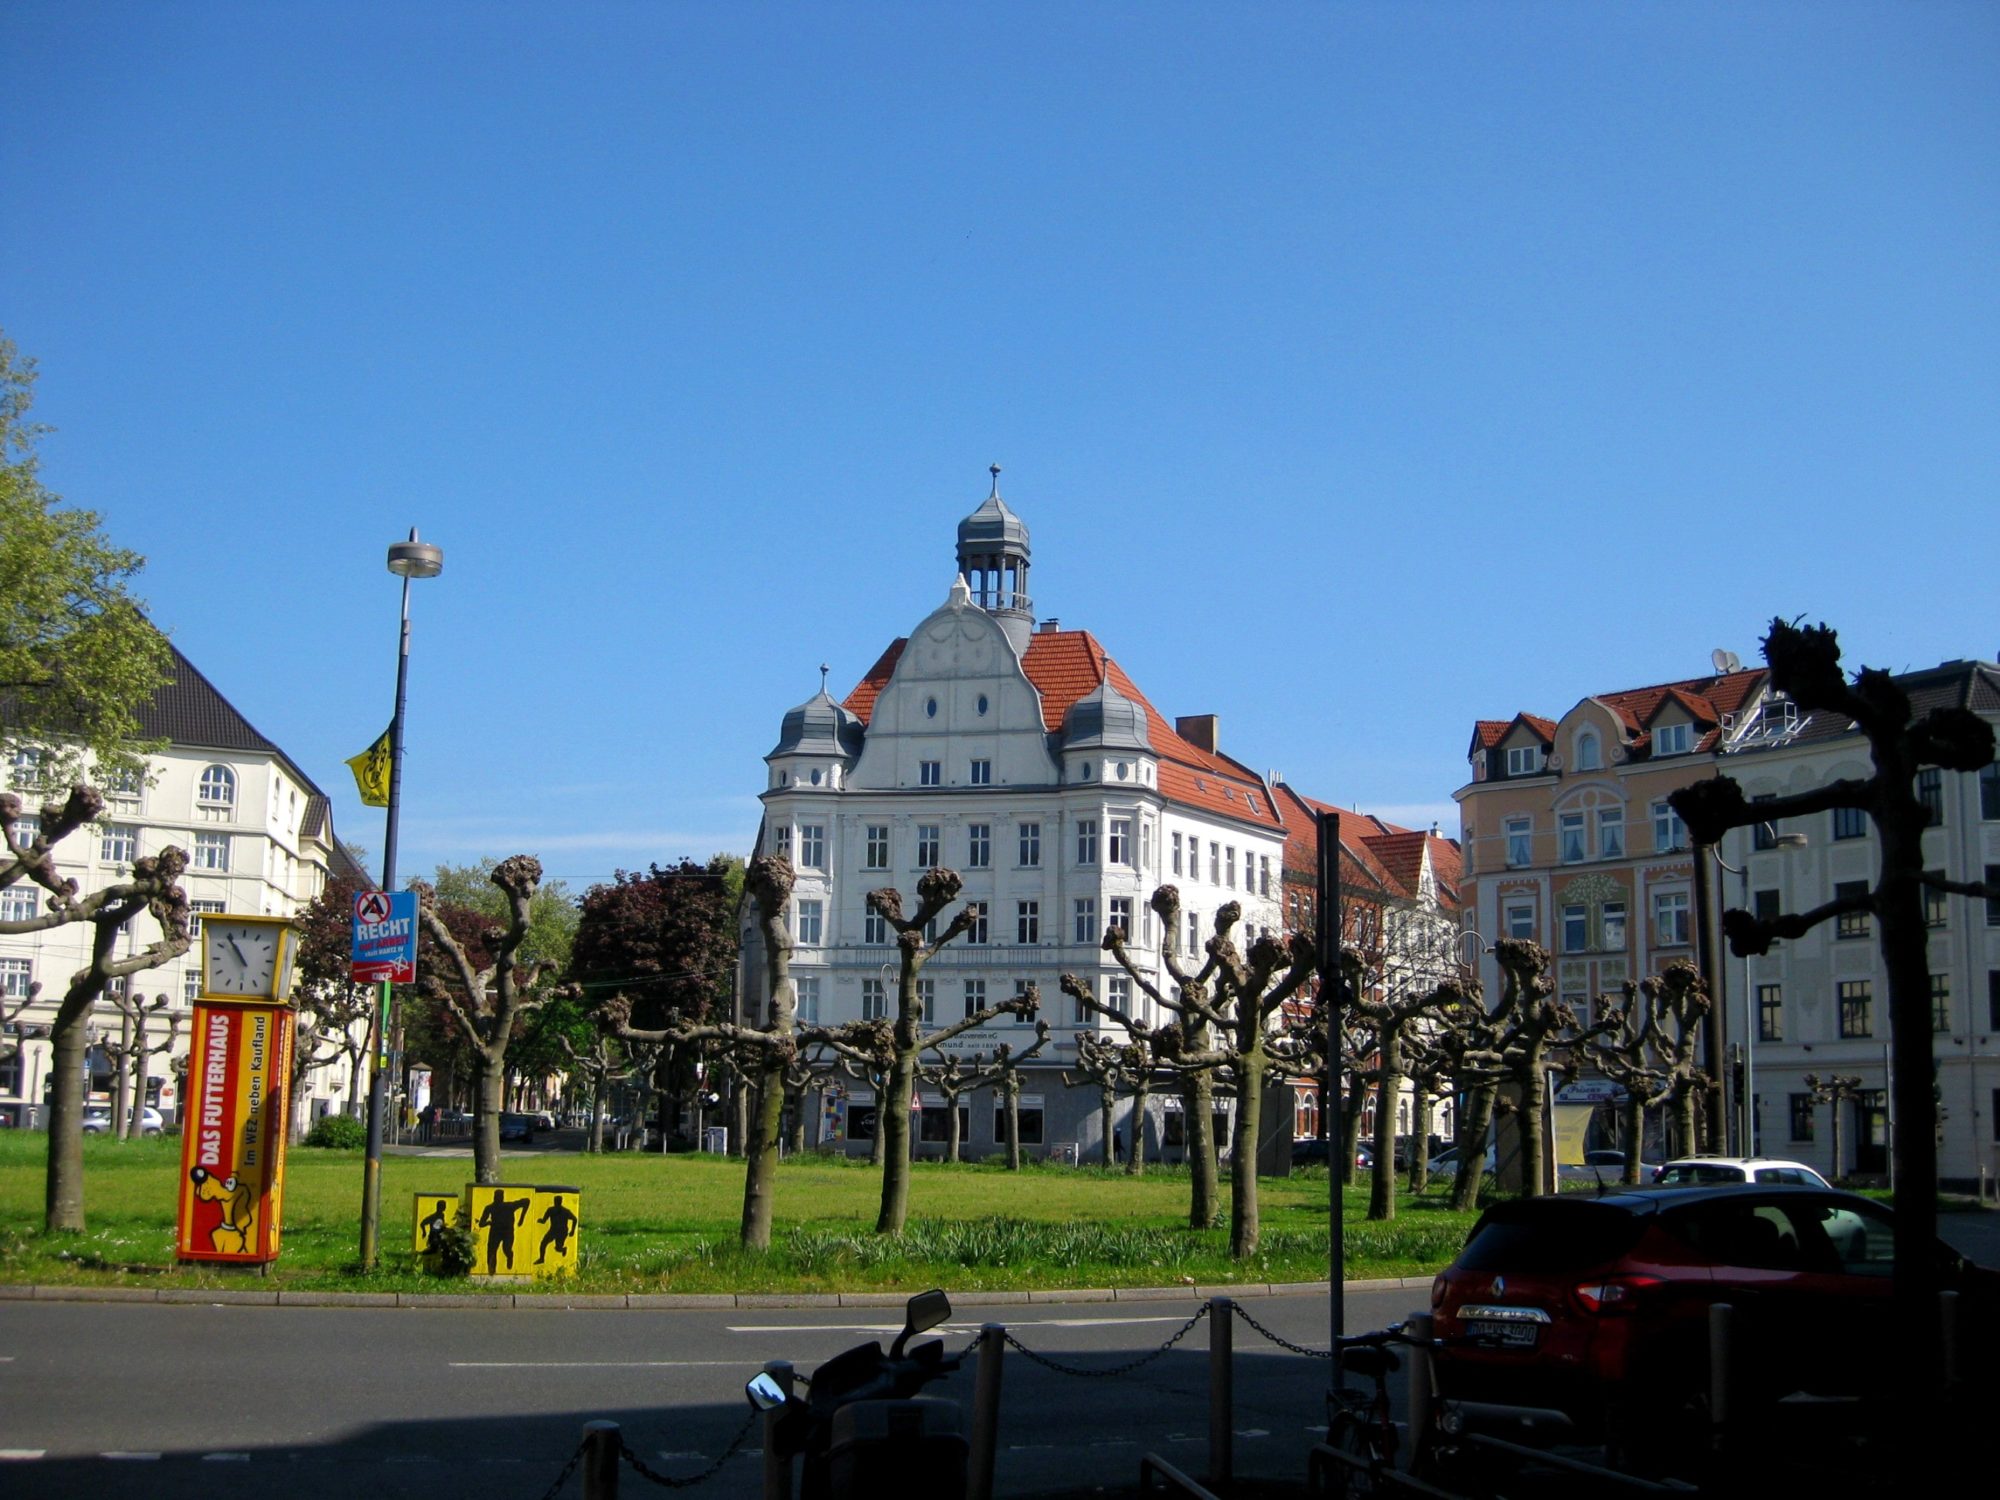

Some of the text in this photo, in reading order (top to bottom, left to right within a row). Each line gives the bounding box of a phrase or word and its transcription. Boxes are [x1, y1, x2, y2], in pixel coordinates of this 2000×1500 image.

[358, 918, 410, 941] RECHT
[201, 1015, 229, 1165] DAS FUTTERHAUS
[243, 1016, 265, 1166] Im WEZ neben Kaufland
